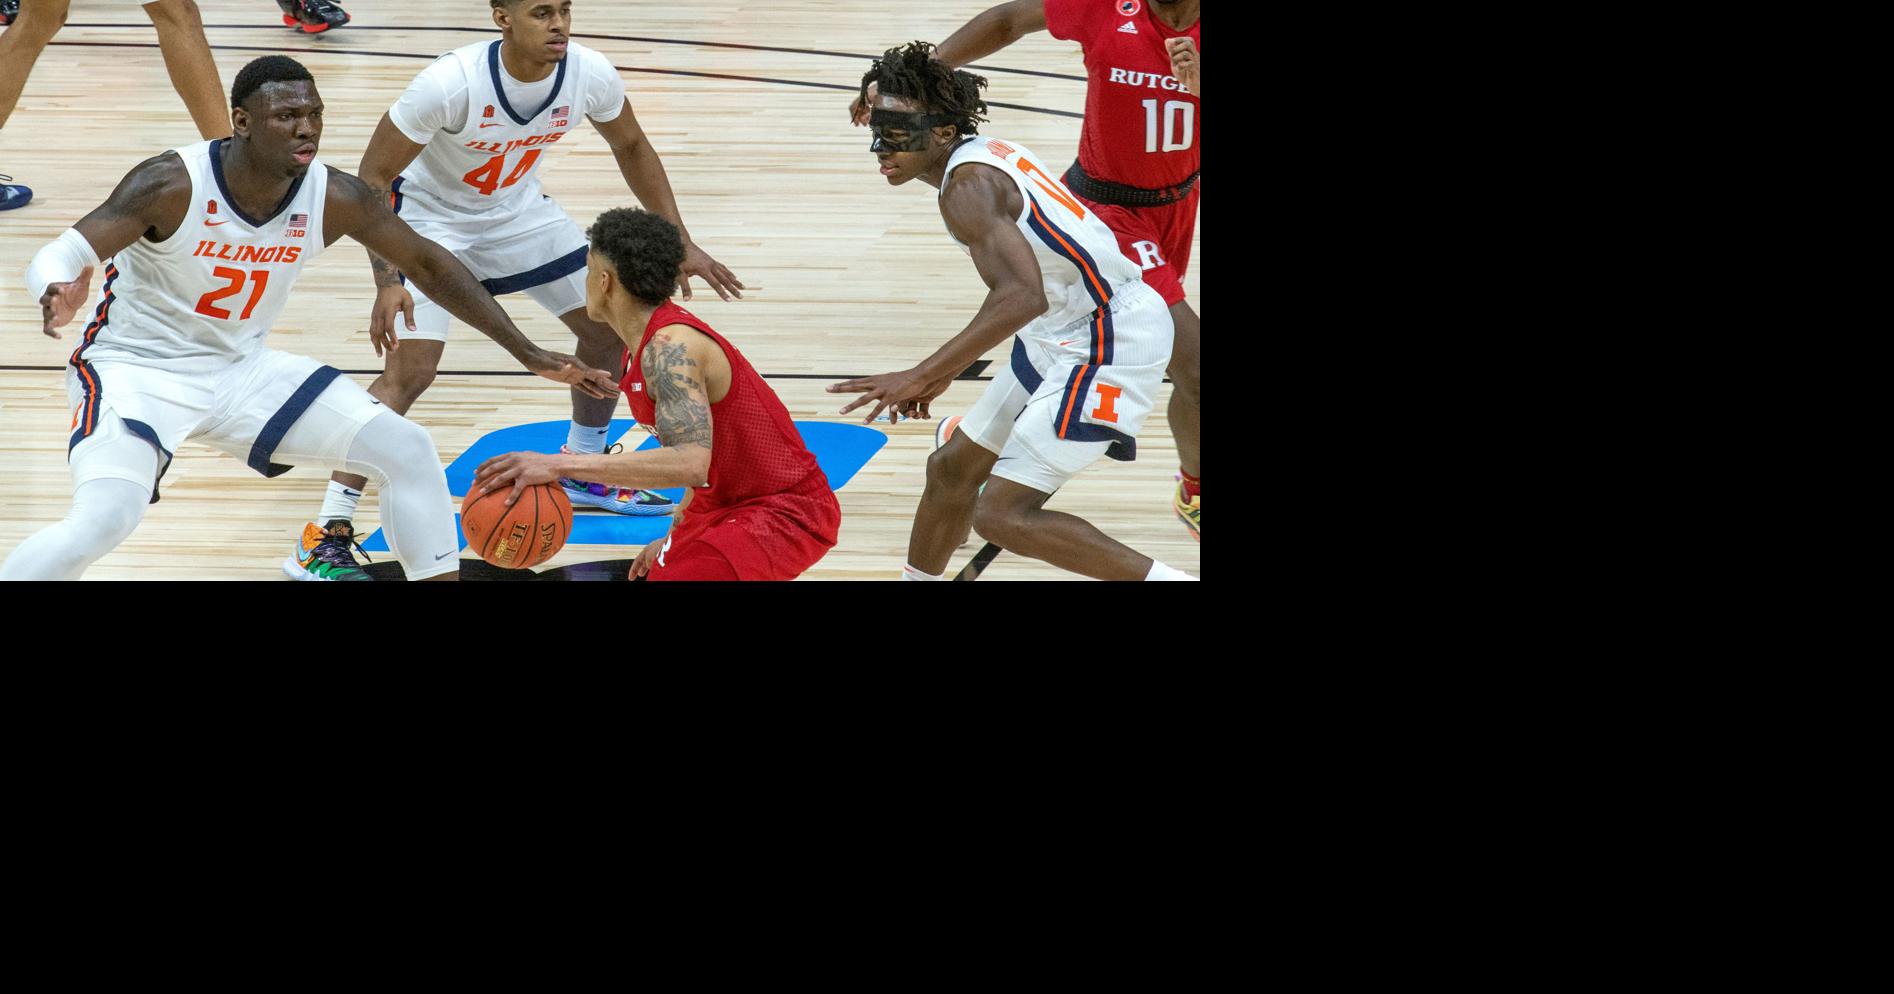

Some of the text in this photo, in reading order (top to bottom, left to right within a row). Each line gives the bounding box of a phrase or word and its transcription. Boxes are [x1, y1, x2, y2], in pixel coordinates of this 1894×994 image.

[464, 131, 567, 155] ILLINOIS
[1142, 99, 1195, 153] 10
[462, 148, 542, 196] 44
[193, 240, 302, 263] ILLINOIS
[1131, 240, 1166, 271] R
[195, 265, 270, 320] 21
[1091, 382, 1122, 424] I
